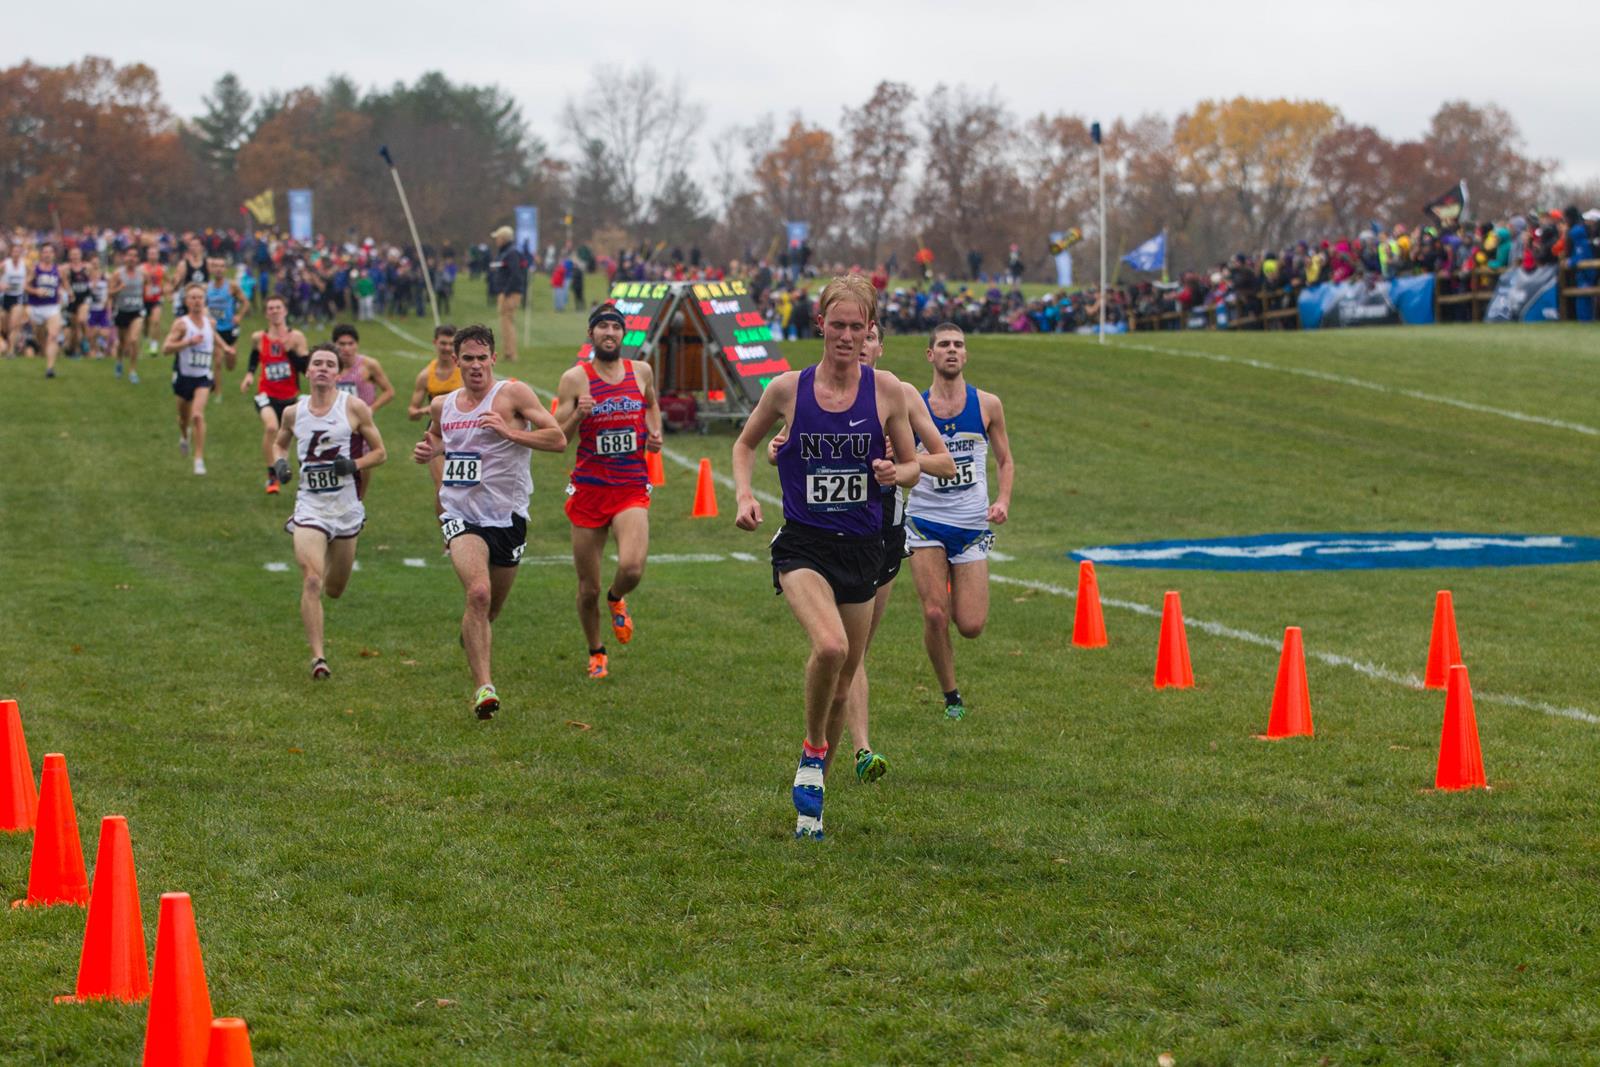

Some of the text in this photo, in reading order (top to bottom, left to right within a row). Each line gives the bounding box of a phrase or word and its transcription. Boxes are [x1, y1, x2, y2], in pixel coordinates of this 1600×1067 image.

[592, 400, 643, 415] PIONEERS
[601, 434, 632, 453] 689
[800, 433, 872, 459] NYU
[446, 460, 477, 480] 448
[307, 471, 339, 489] 686
[813, 475, 862, 502] 526
